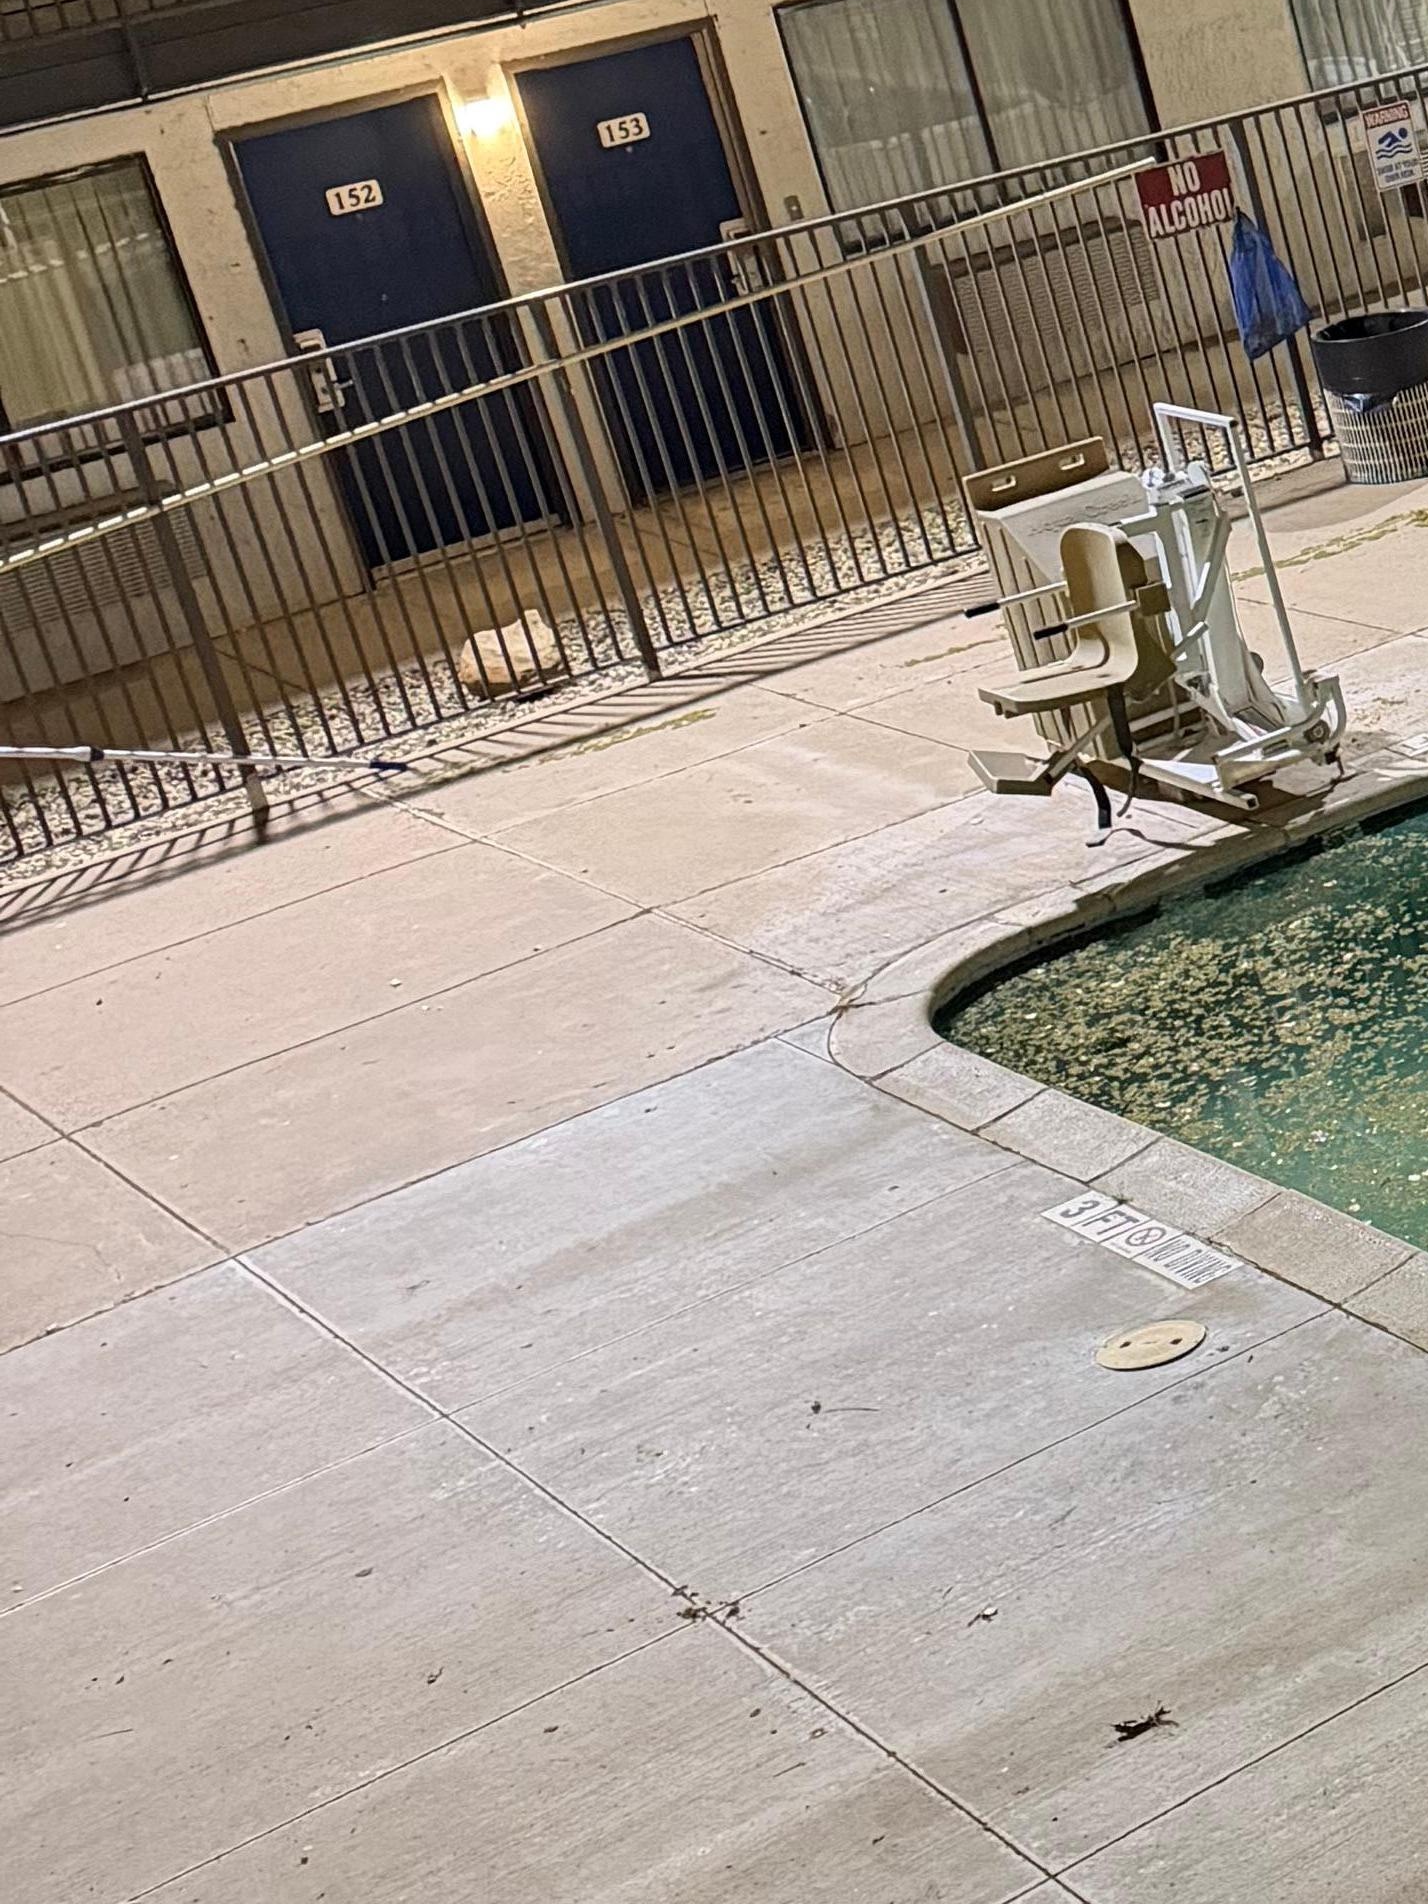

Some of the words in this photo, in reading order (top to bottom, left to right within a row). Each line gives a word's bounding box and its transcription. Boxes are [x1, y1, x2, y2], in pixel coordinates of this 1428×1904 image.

[606, 117, 643, 142] 153
[1168, 161, 1200, 196] NO
[334, 185, 376, 210] 152
[1060, 1200, 1100, 1218] 3
[1082, 1210, 1140, 1235] FT
[1147, 1238, 1190, 1262] NO
[1164, 1249, 1232, 1284] DIVING
